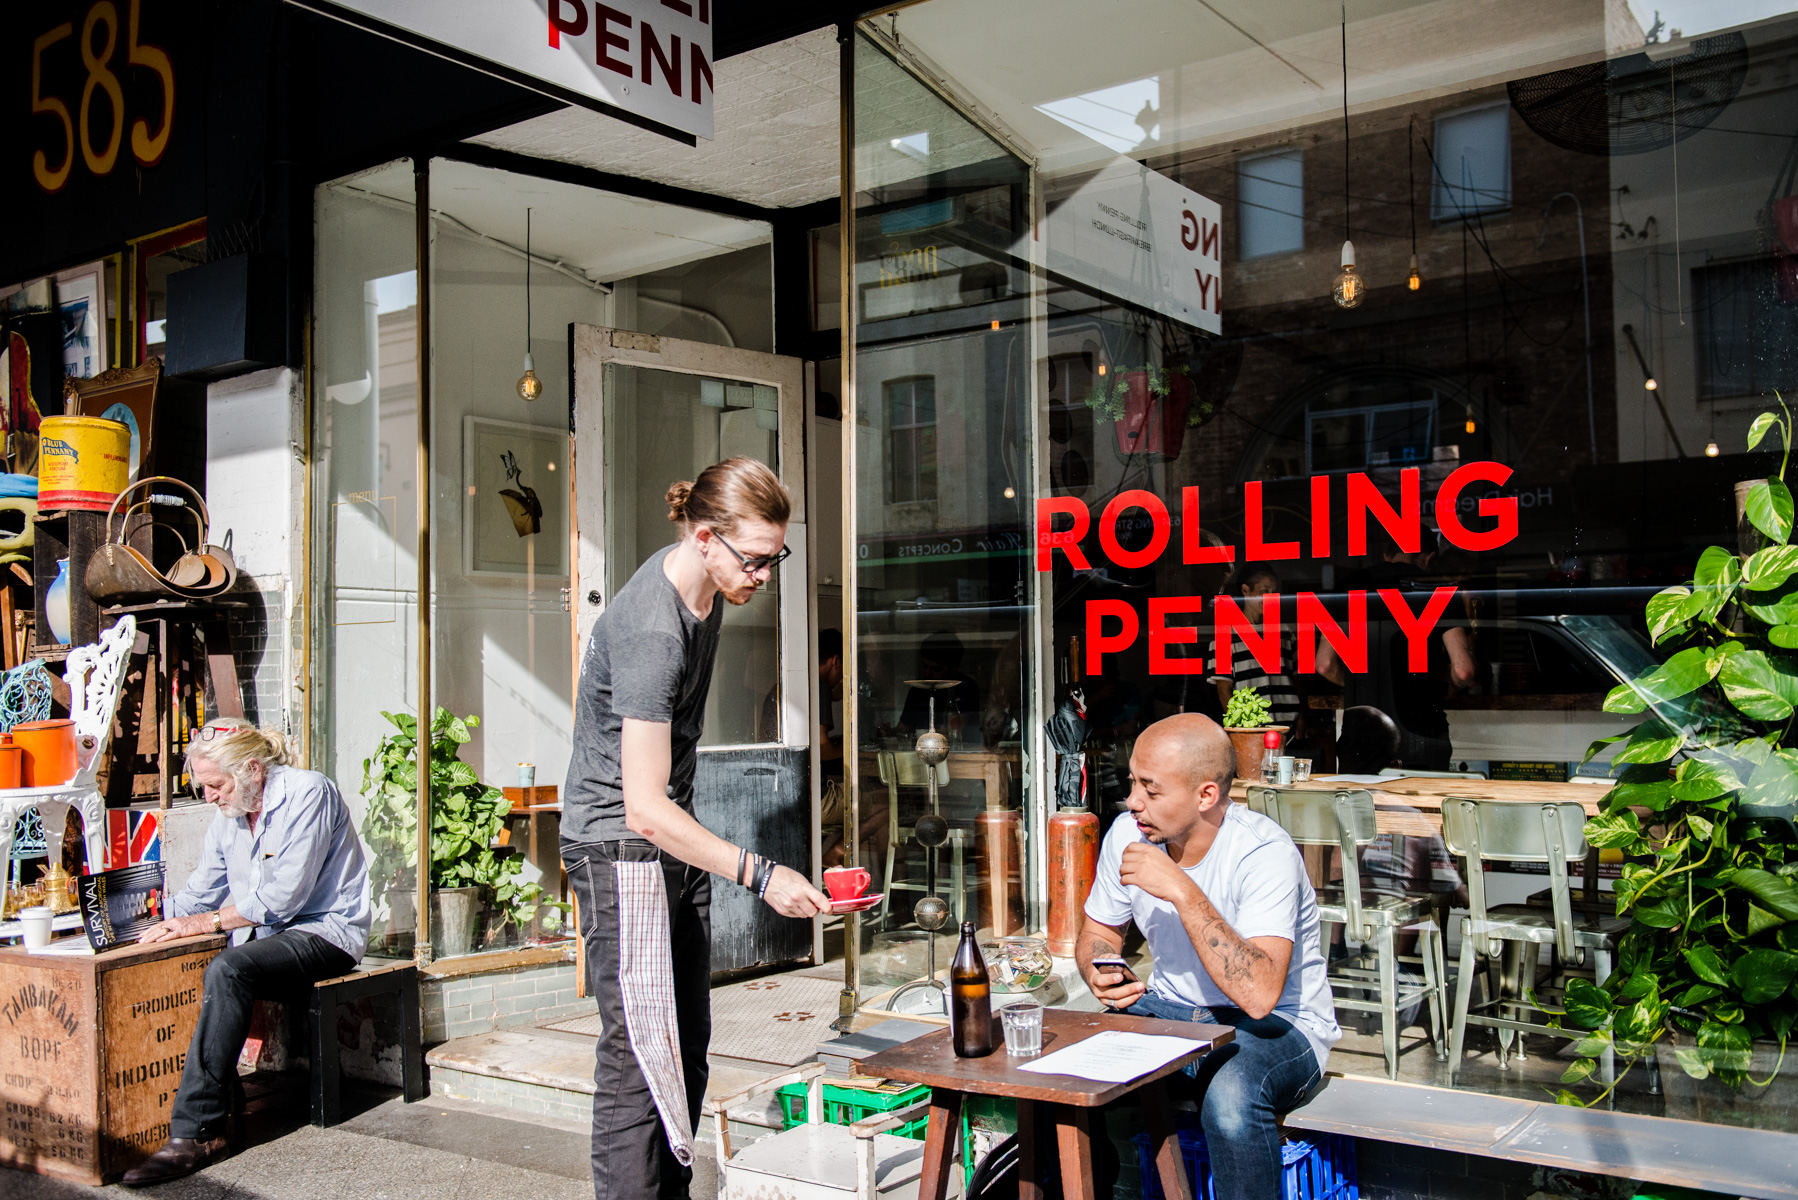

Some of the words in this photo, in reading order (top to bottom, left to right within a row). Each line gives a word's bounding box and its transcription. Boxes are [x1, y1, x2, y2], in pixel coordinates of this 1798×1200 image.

[32, 0, 176, 194] 585
[46, 438, 64, 448] BLUE
[348, 489, 379, 505] menu
[1036, 460, 1520, 572] ROLLING
[1085, 586, 1459, 676] PENNY
[84, 876, 109, 946] SURVIVAL
[132, 987, 197, 1018] PRODUCE
[156, 1023, 176, 1043] OF
